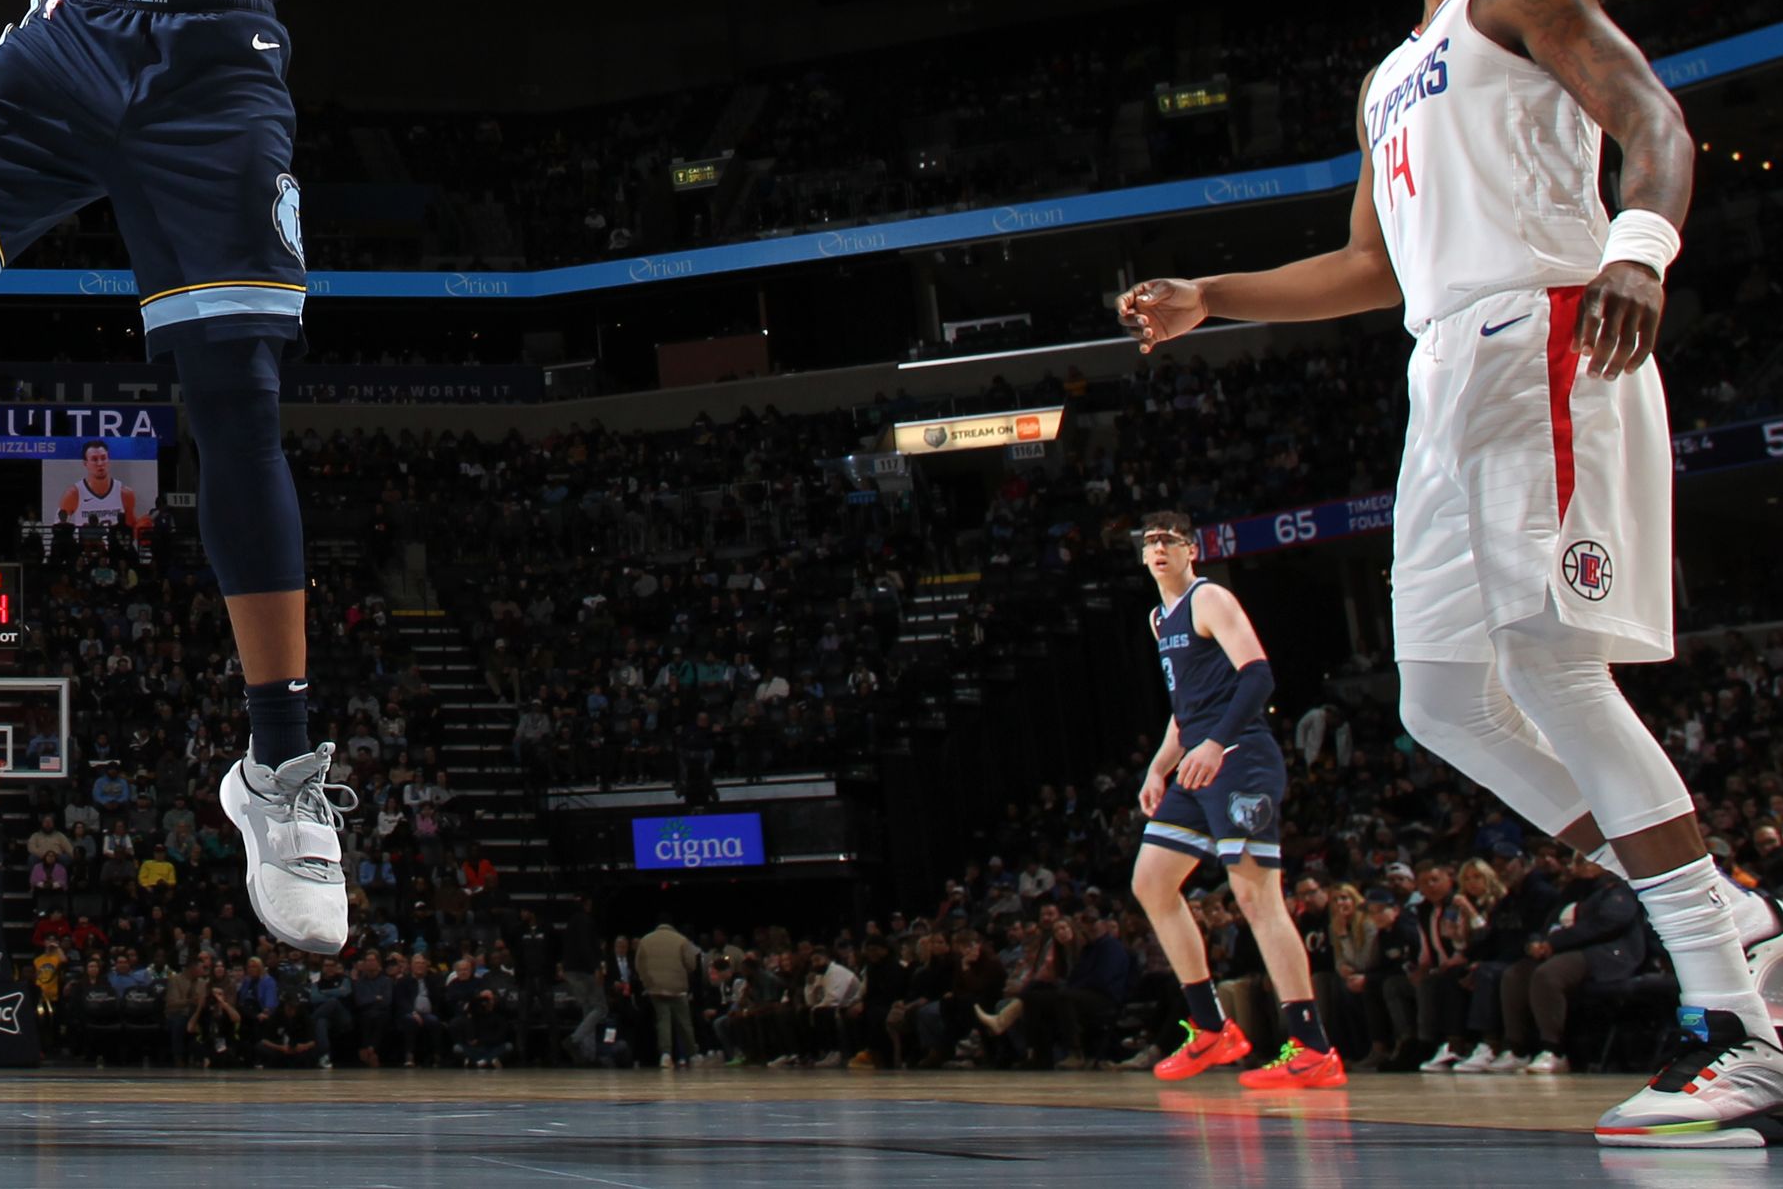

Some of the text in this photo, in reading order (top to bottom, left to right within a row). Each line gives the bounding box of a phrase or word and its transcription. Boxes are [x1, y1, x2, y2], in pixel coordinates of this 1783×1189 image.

[1384, 127, 1416, 212] 14
[1203, 176, 1281, 206] Orion
[992, 202, 1064, 234] Orion
[817, 228, 886, 258] Orion
[628, 256, 693, 283] Orion
[443, 273, 509, 297] Orion
[409, 384, 481, 398] WORTH
[492, 384, 512, 398] IT
[951, 427, 995, 441] STREAM
[997, 425, 1014, 436] ON
[880, 459, 899, 471] 117
[1015, 446, 1042, 458] 116A
[172, 494, 191, 506] 118
[1274, 510, 1317, 544] 65
[654, 832, 745, 868] cigna
